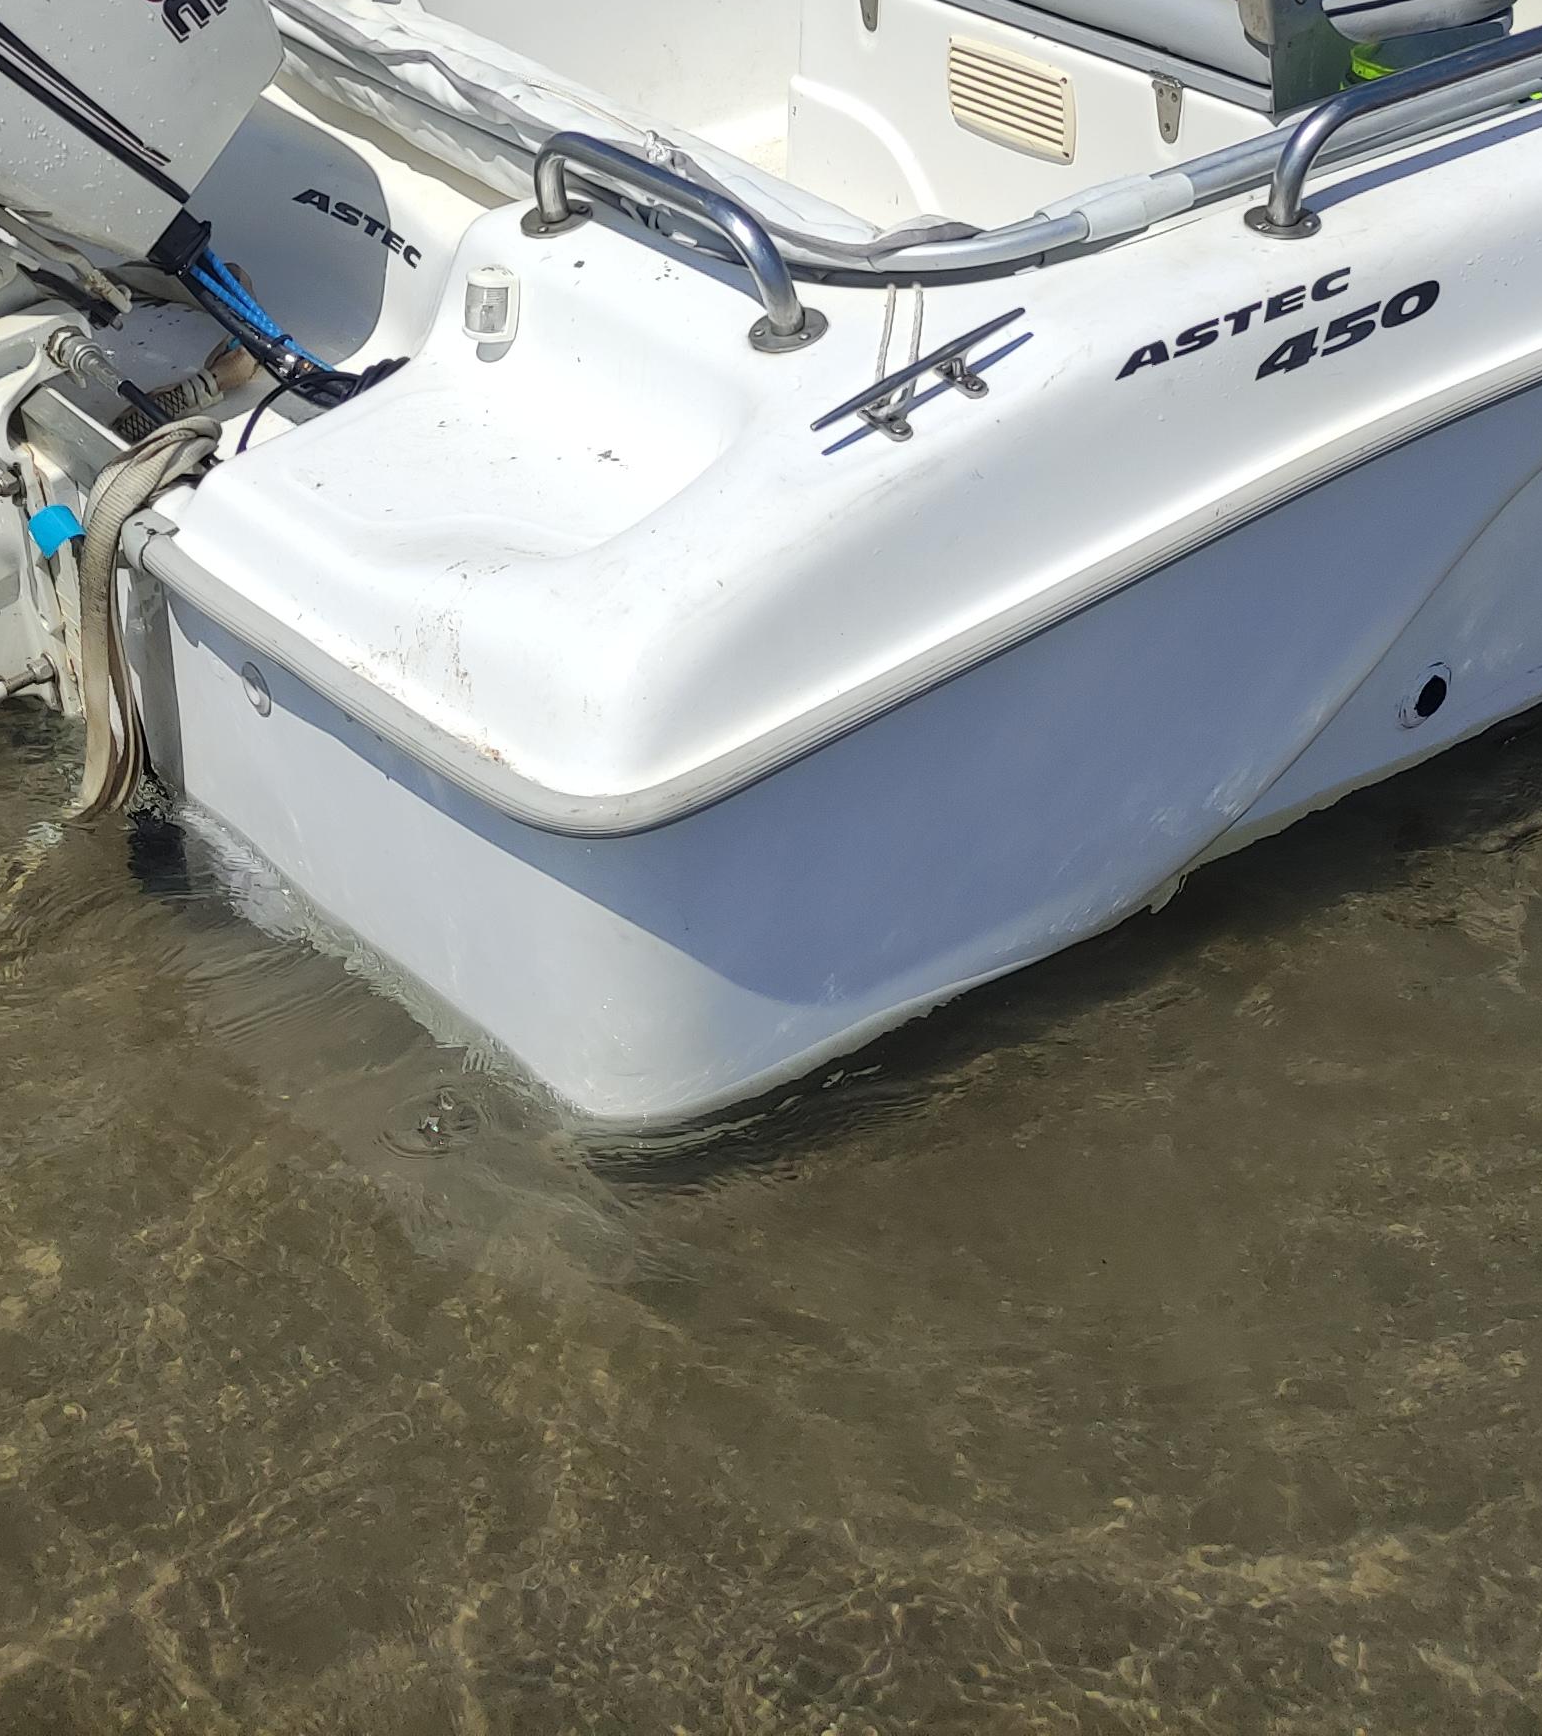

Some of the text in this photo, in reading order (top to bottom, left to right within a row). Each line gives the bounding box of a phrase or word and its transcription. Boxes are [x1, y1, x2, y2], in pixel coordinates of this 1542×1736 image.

[291, 188, 422, 269] ASTEC
[1114, 266, 1351, 381] ASTEC
[1254, 279, 1441, 382] 450
